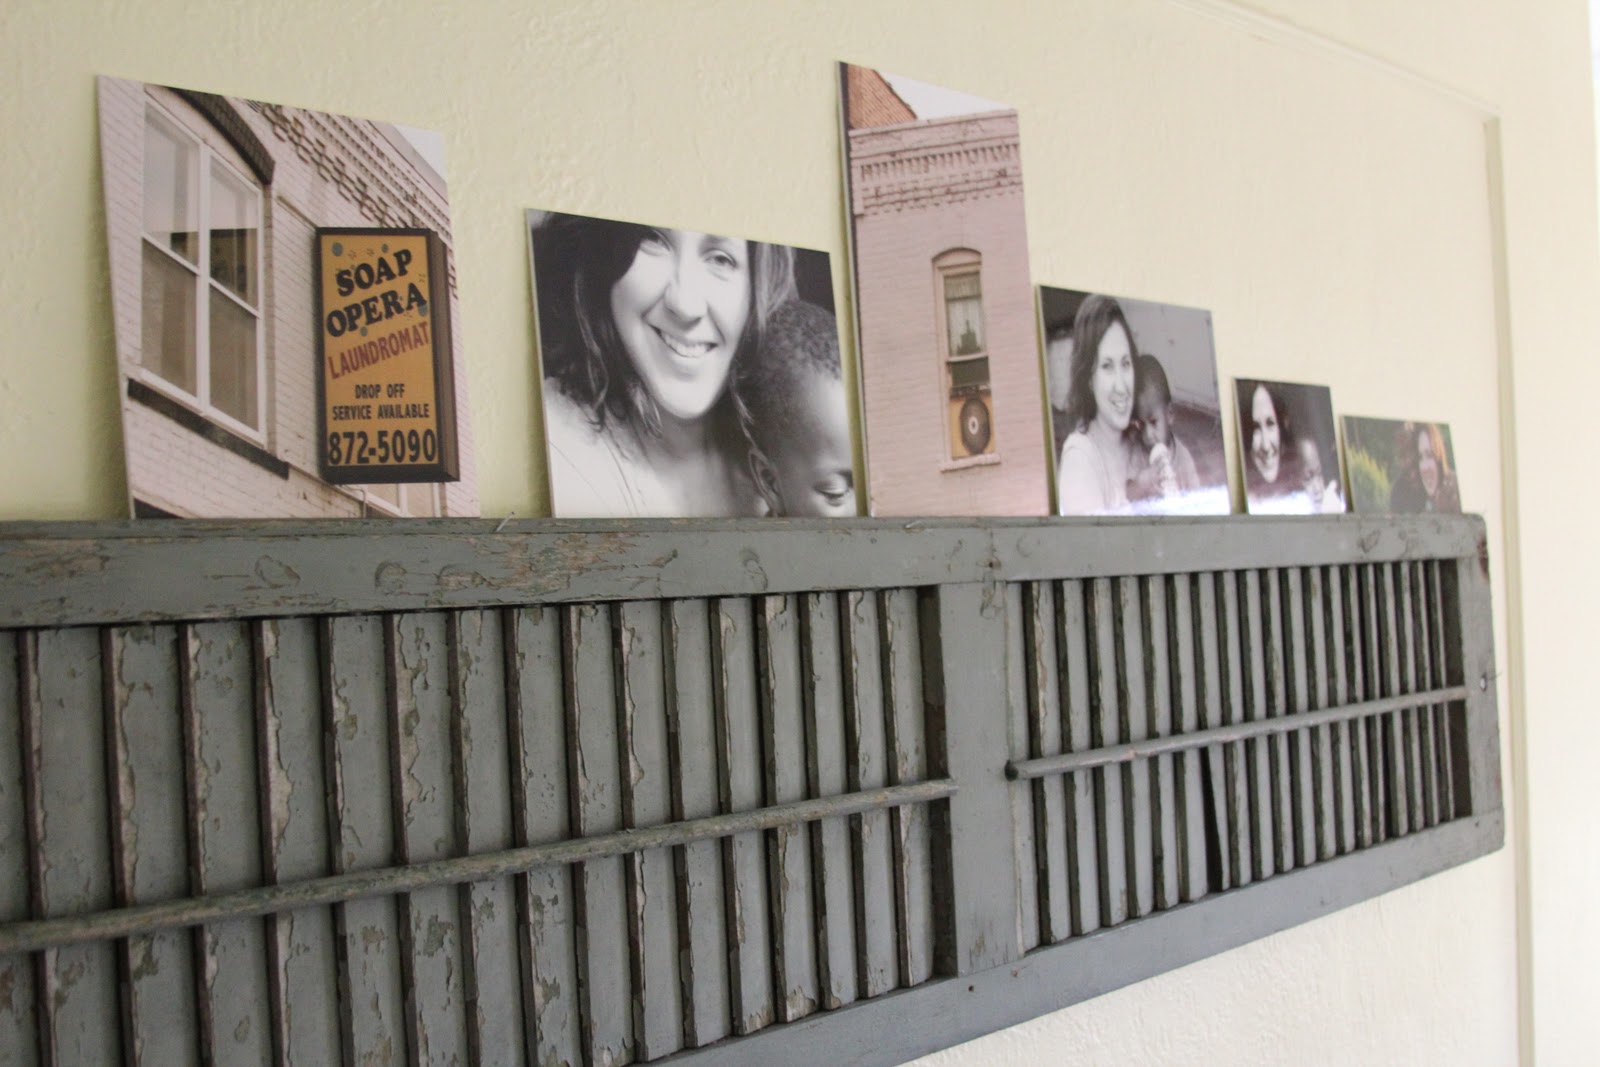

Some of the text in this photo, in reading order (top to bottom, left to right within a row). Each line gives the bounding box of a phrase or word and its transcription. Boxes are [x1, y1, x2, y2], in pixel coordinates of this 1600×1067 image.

[336, 249, 412, 297] SOAP
[326, 282, 427, 337] OPERA
[328, 321, 430, 379] LAUNDROMAT
[332, 403, 430, 420] SERVICE AVAILABLE
[355, 383, 405, 399] DROP OFF
[329, 429, 436, 465] 872-5090
